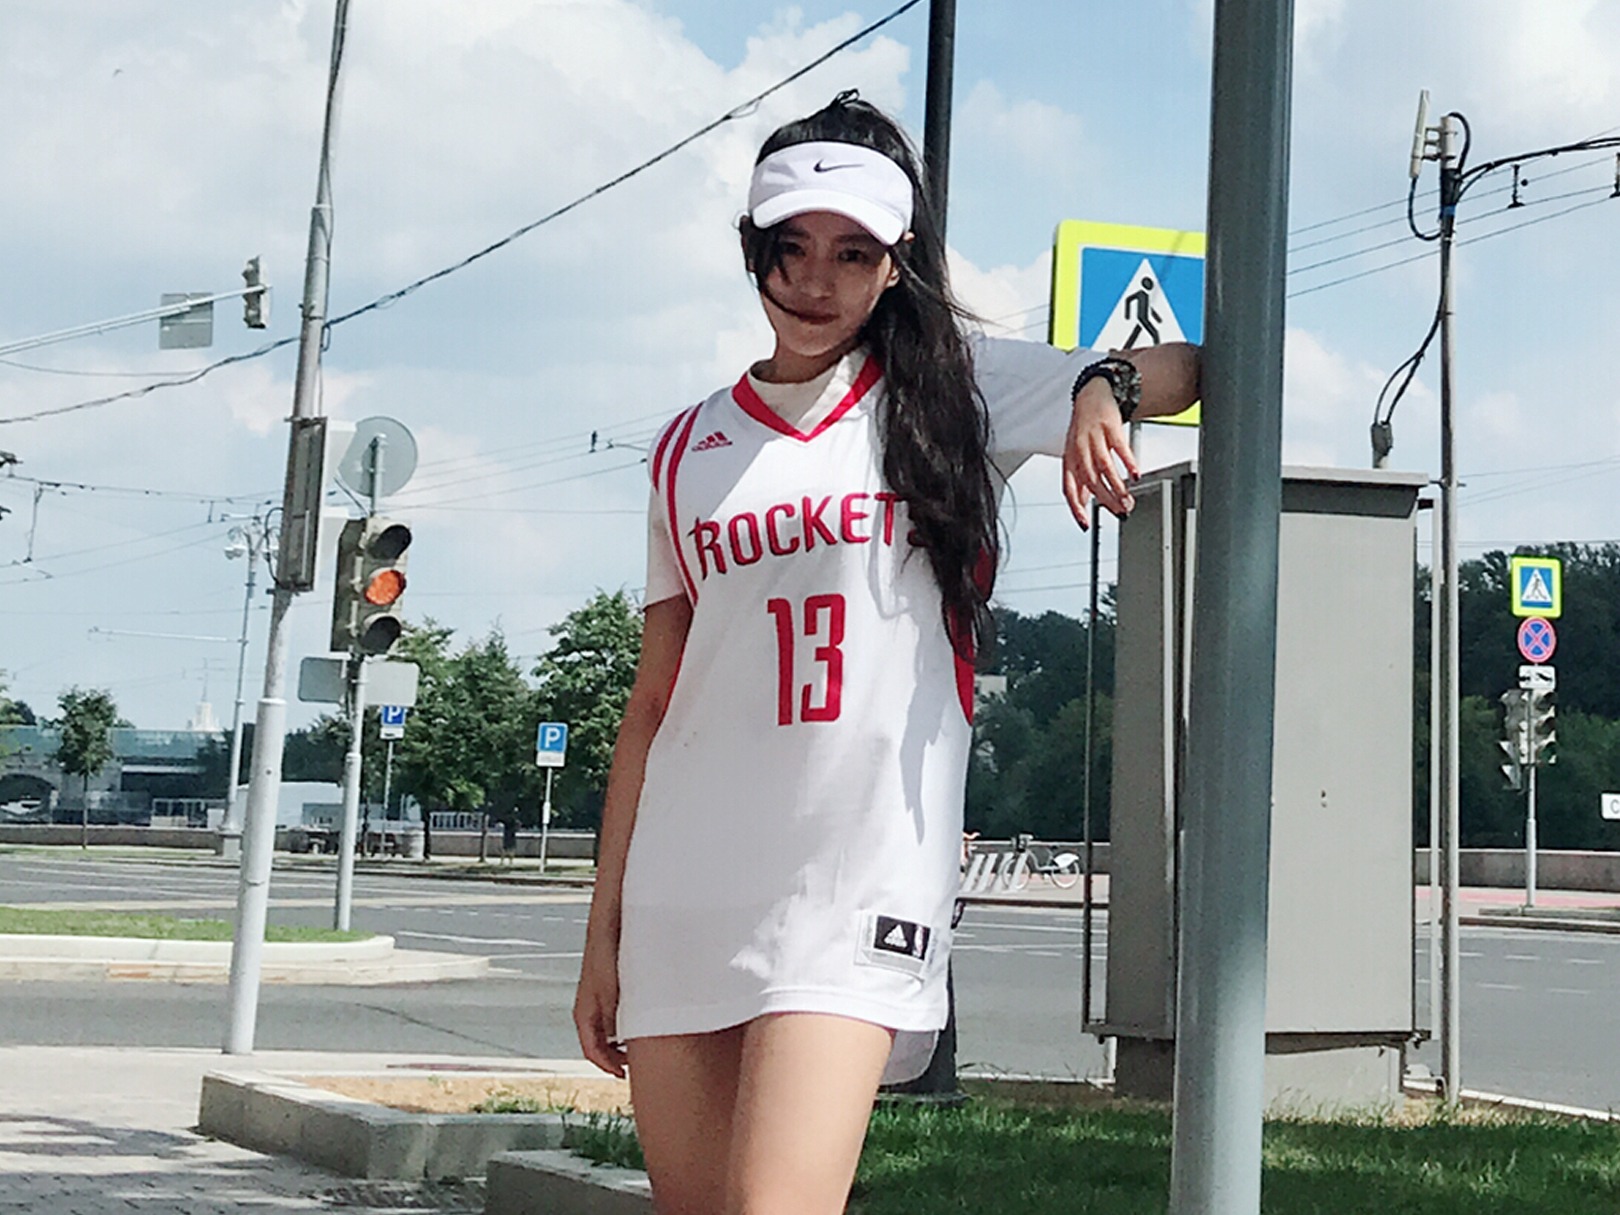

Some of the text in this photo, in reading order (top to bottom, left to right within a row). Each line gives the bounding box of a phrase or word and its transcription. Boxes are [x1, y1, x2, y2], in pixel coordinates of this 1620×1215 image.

[687, 491, 927, 581] ROCKET
[767, 593, 846, 726] 13
[387, 705, 401, 722] P
[544, 727, 561, 748] P
